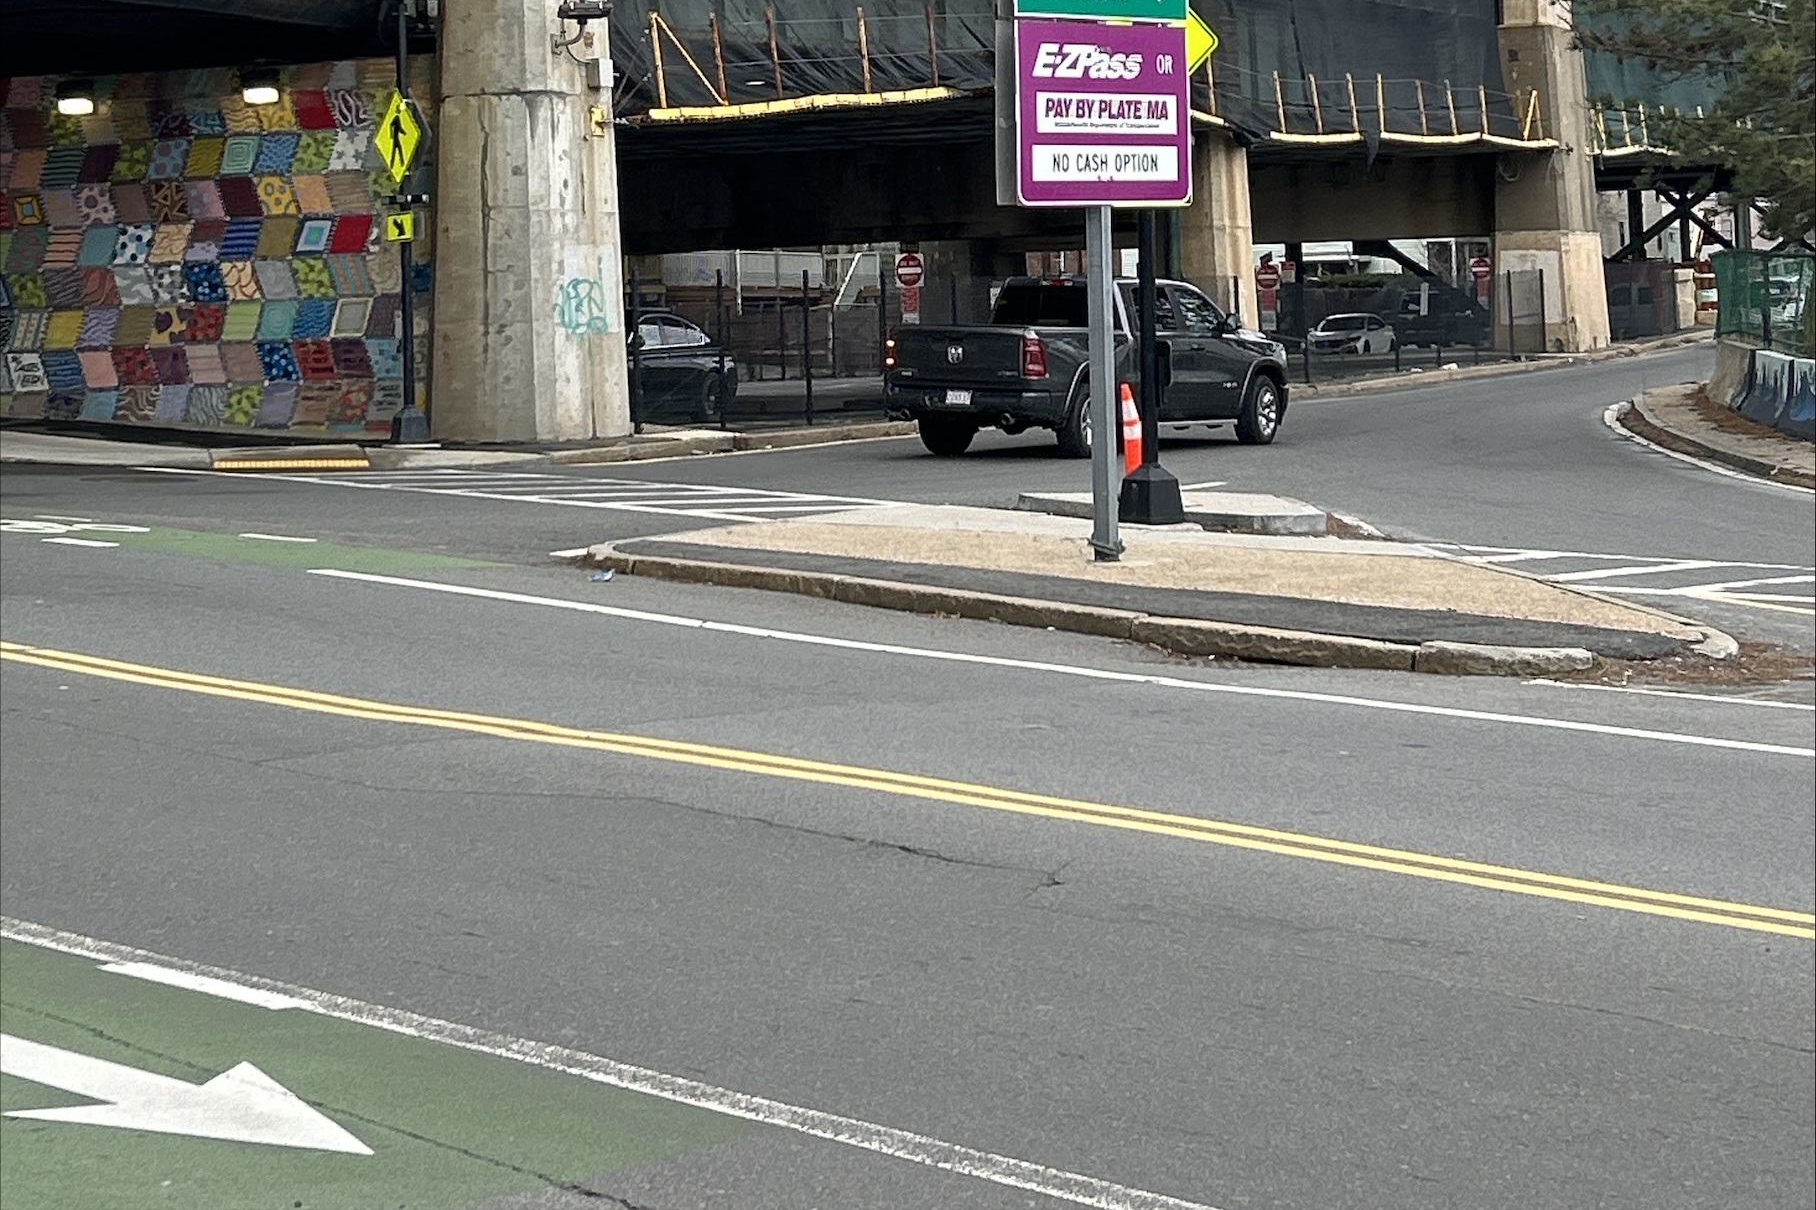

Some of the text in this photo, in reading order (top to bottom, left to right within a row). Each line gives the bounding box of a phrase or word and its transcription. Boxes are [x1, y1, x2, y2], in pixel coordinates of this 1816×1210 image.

[1155, 54, 1174, 75] OR
[1045, 97, 1168, 120] PAY BY PLATE MA
[1052, 153, 1159, 172] NO CASH OPTION
